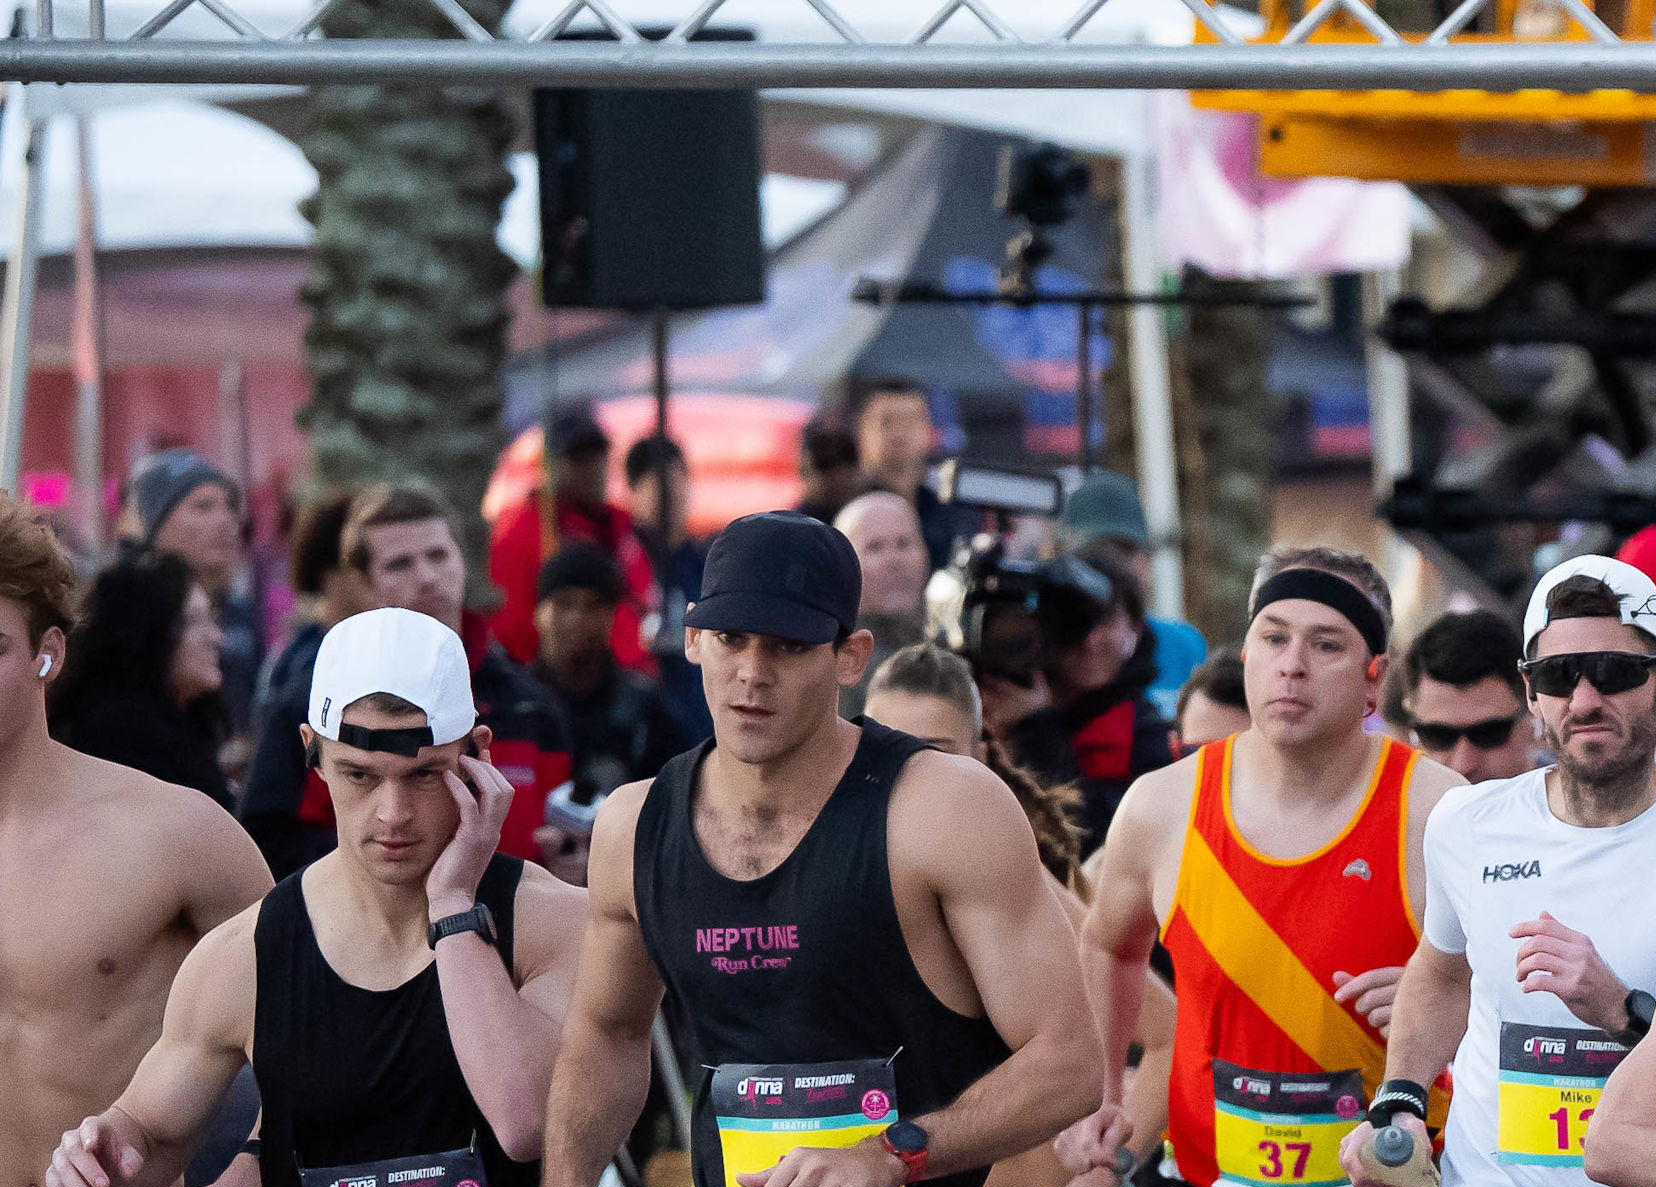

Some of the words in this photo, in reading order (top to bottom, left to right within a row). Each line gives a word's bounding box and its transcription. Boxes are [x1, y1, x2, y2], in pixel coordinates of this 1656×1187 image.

[1483, 860, 1542, 884] HOKA
[696, 925, 799, 952] NEPTUNE
[712, 957, 748, 974] Run
[751, 957, 789, 971] Crew
[794, 1073, 855, 1088] DESTINATION:
[1560, 1090, 1593, 1104] Mike
[1258, 1140, 1312, 1178] 37
[388, 1166, 446, 1184] DESTINATION:
